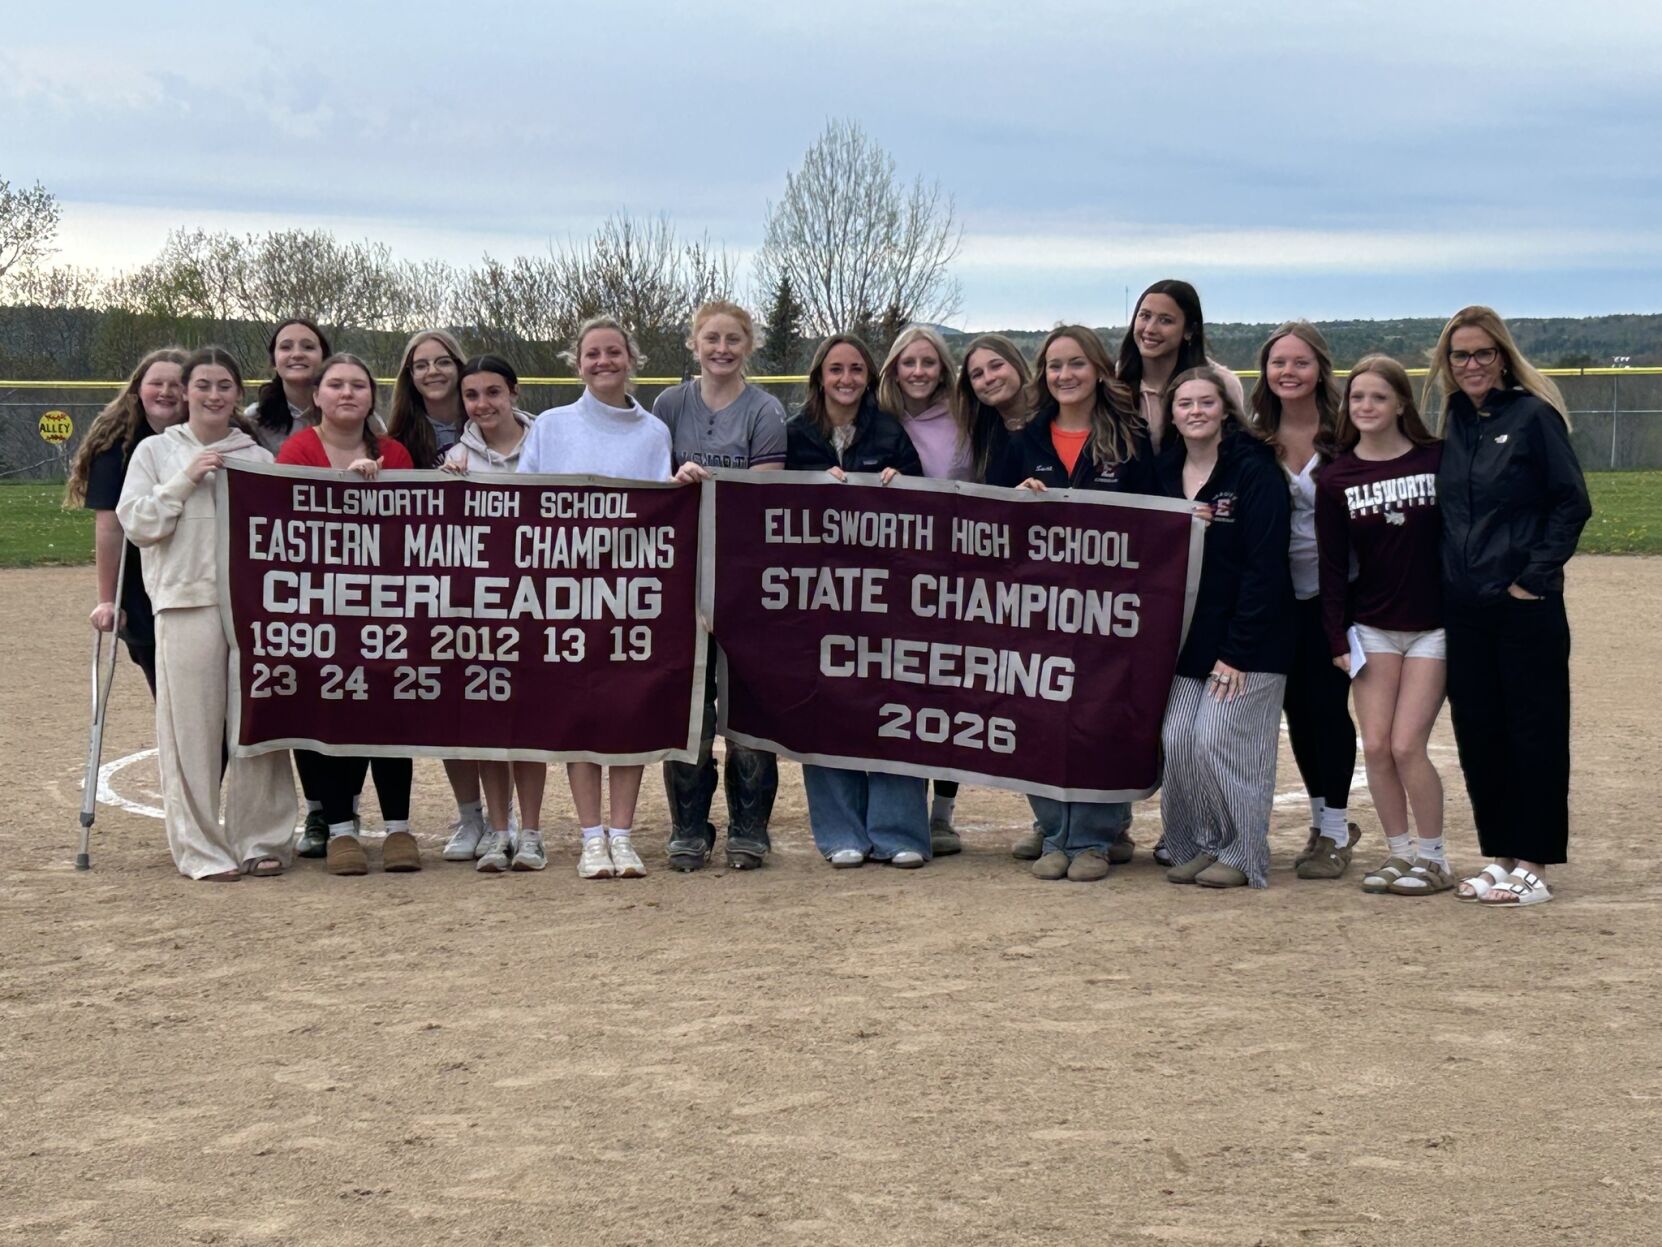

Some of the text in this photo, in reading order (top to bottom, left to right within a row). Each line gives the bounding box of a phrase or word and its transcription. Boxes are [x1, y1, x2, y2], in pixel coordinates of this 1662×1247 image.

[293, 485, 637, 518] ELLSWORTH HIGH SCHOOL
[1344, 473, 1436, 511] ELLSWORTH
[250, 517, 674, 569] EASTERN MAINE CHAMPIONS
[766, 509, 1139, 568] ELLSWORTH HIGH SCHOOL
[263, 570, 662, 619] CHEERLEADING
[762, 567, 1140, 637] STATE CHAMPIONS
[250, 622, 651, 662] 1990 92 2012 13 19
[251, 663, 511, 701] 23 24 25 26
[820, 635, 1075, 701] CHEERING
[878, 704, 1016, 753] 2026
